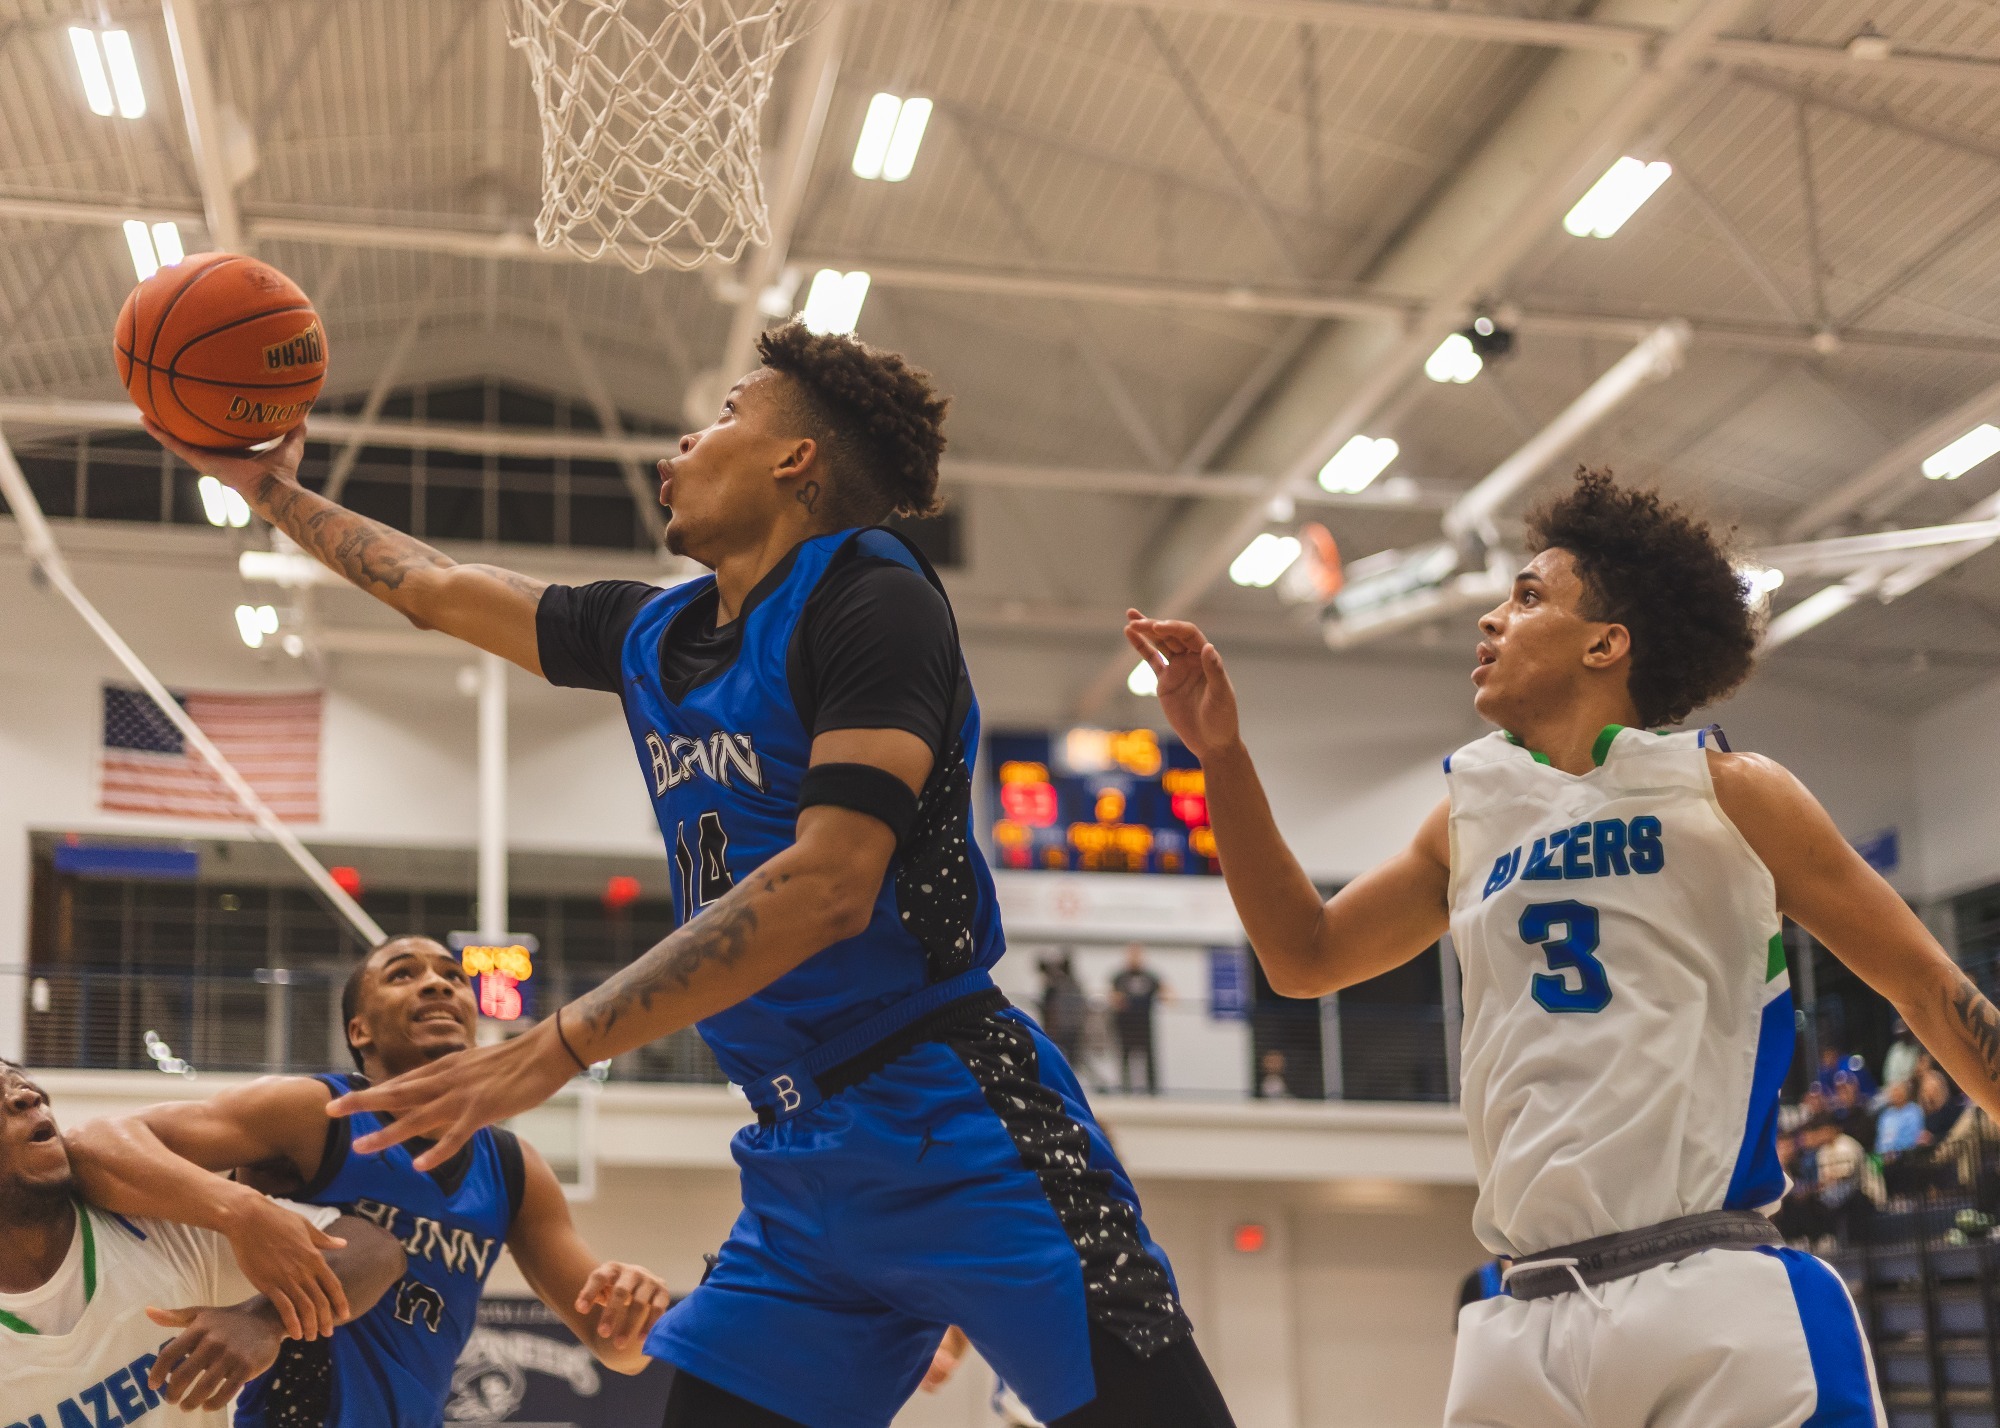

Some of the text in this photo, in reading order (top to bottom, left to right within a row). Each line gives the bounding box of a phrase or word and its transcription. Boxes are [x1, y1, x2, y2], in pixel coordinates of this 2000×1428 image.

[225, 395, 317, 424] ALDING
[675, 811, 735, 926] 14
[1518, 899, 1613, 1013] 3
[771, 1074, 800, 1112] B
[4, 1336, 188, 1428] AZER
